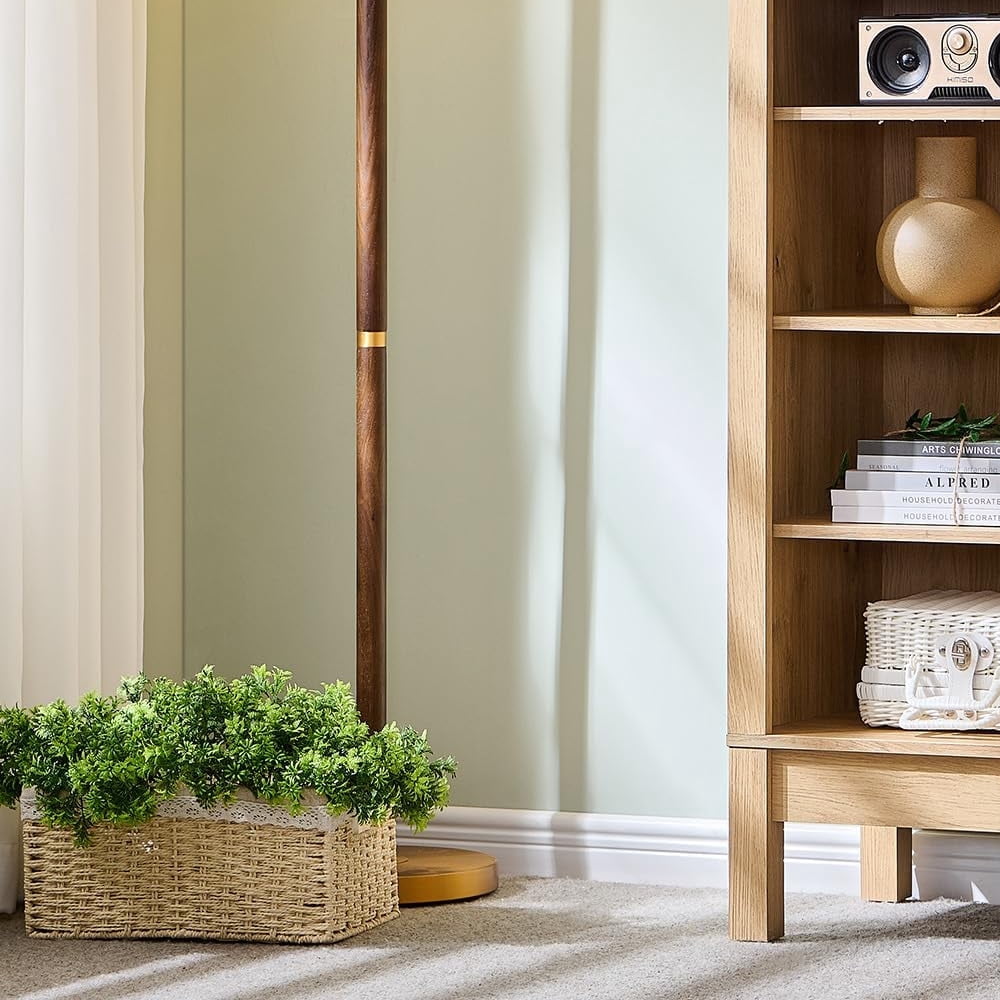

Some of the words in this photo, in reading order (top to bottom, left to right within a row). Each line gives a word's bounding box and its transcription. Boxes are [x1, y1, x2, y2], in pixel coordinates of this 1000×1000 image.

[922, 446, 946, 454] ARTS
[925, 478, 990, 488] ALPRED
[902, 496, 954, 504] HOUSEHOLD
